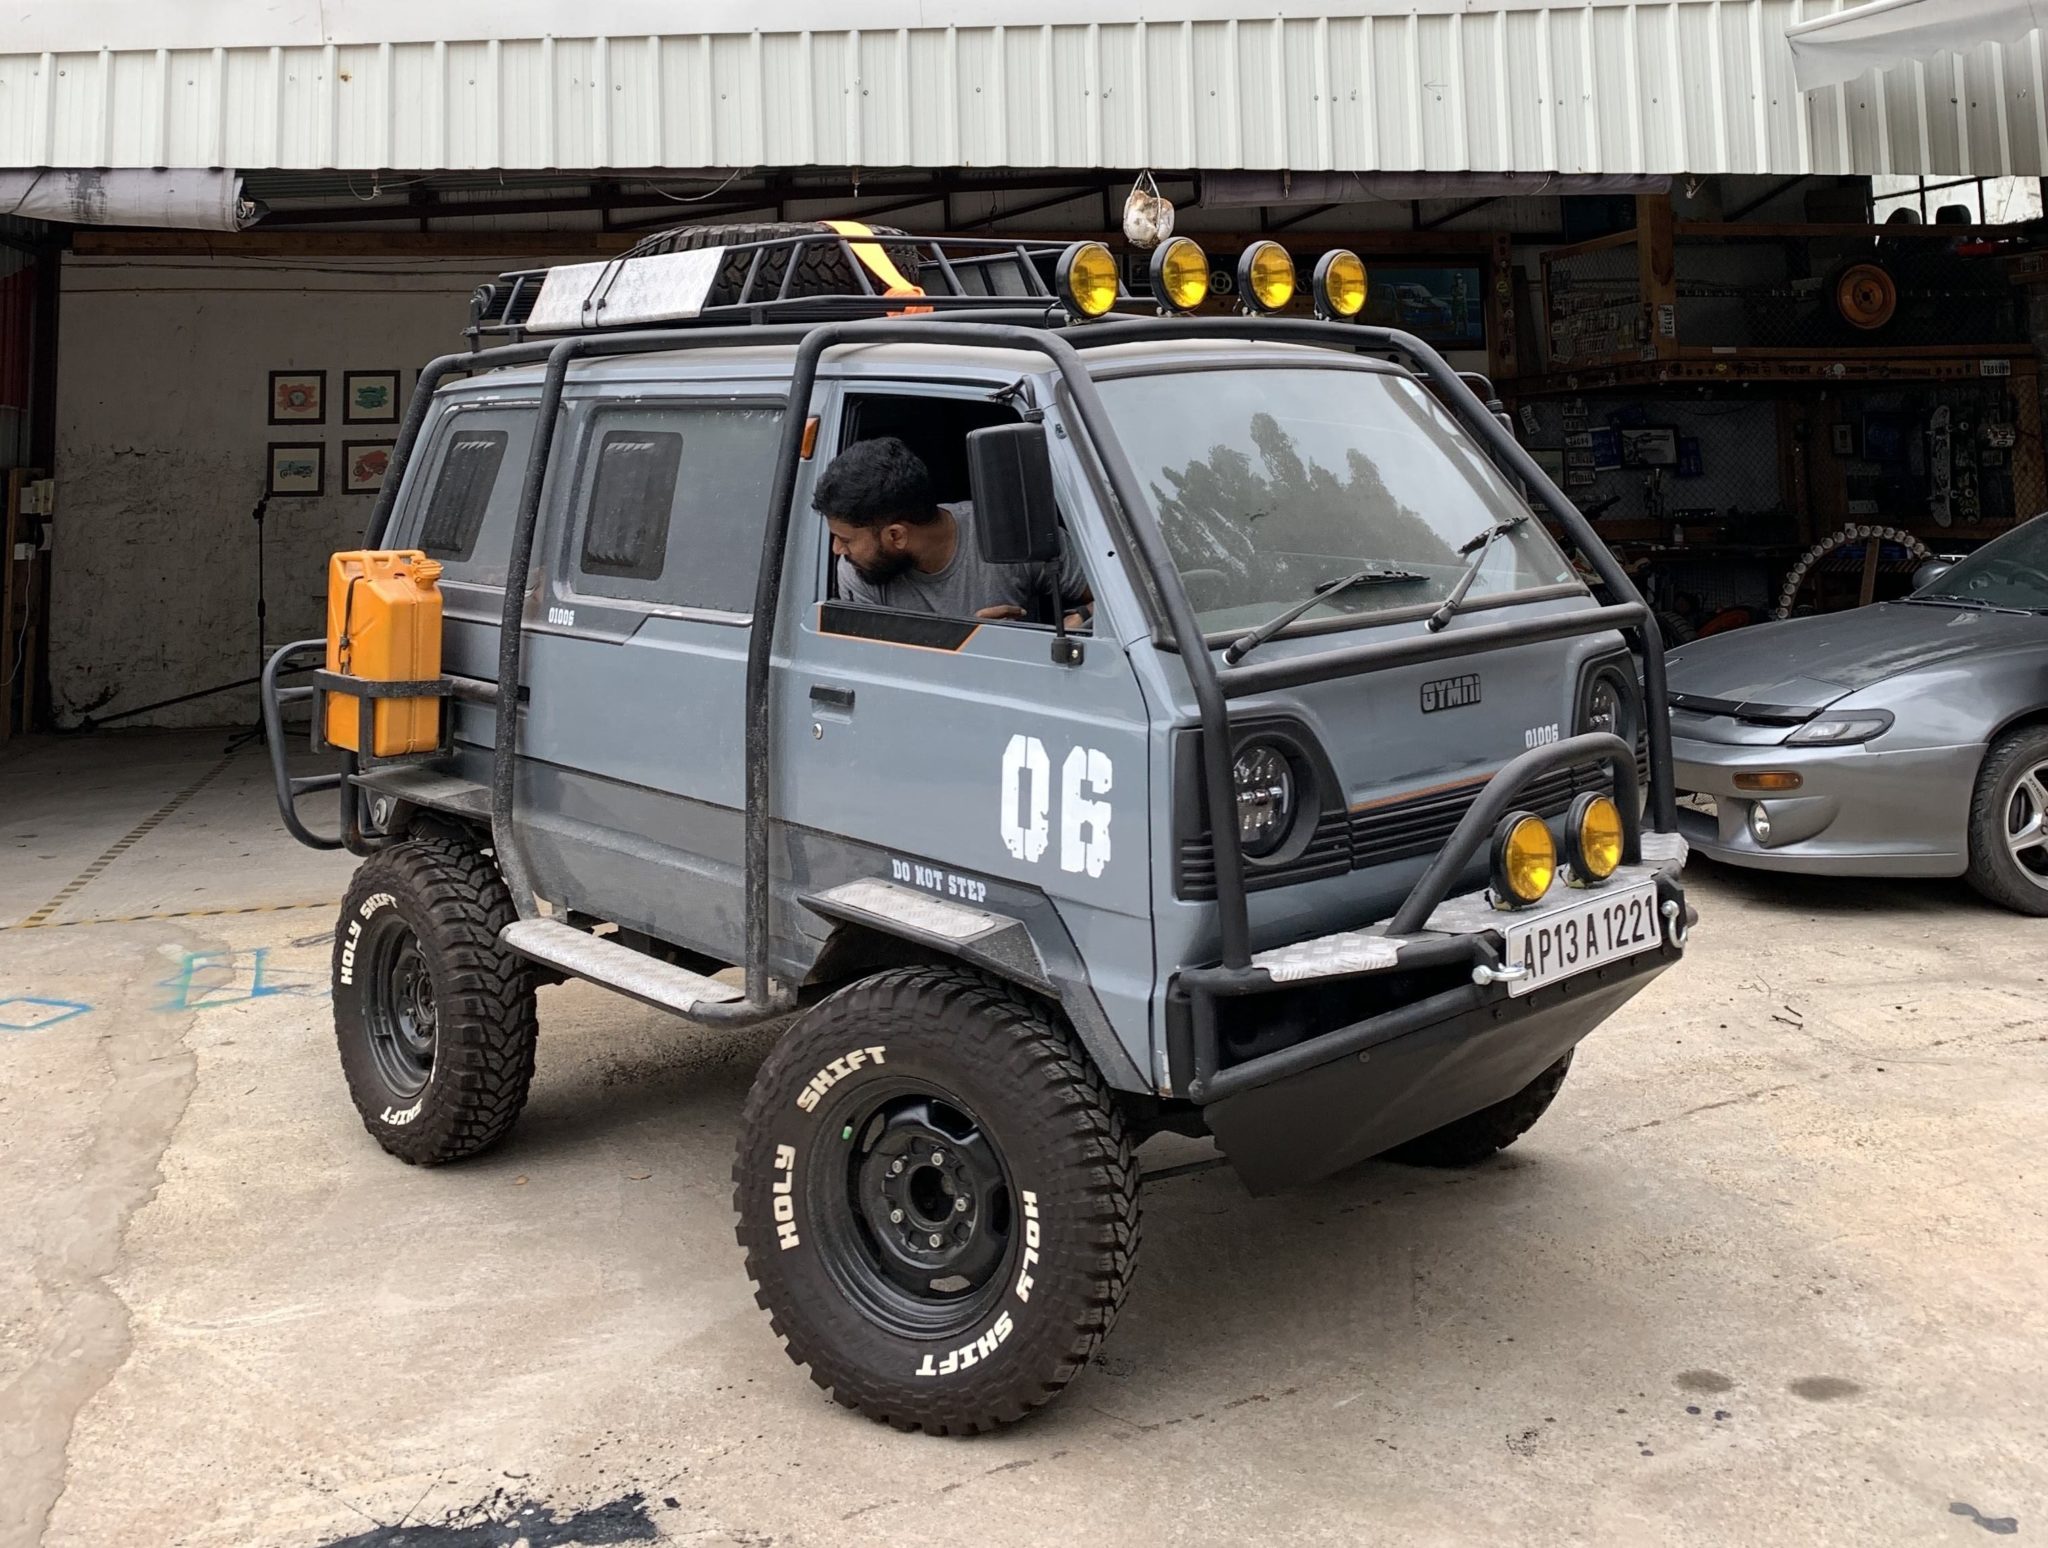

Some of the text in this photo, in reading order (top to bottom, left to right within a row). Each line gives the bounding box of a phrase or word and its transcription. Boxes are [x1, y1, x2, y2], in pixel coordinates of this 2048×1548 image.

[1525, 723, 1559, 749] 01006
[1001, 734, 1112, 878] 06
[892, 859, 987, 903] DO NOT STEP
[341, 892, 398, 986] HOLY SHIFT
[1524, 895, 1656, 981] AP13 A 1221
[773, 1045, 886, 1250] HOLY SHIFT
[915, 1190, 1041, 1376] HOLY SHIFT
